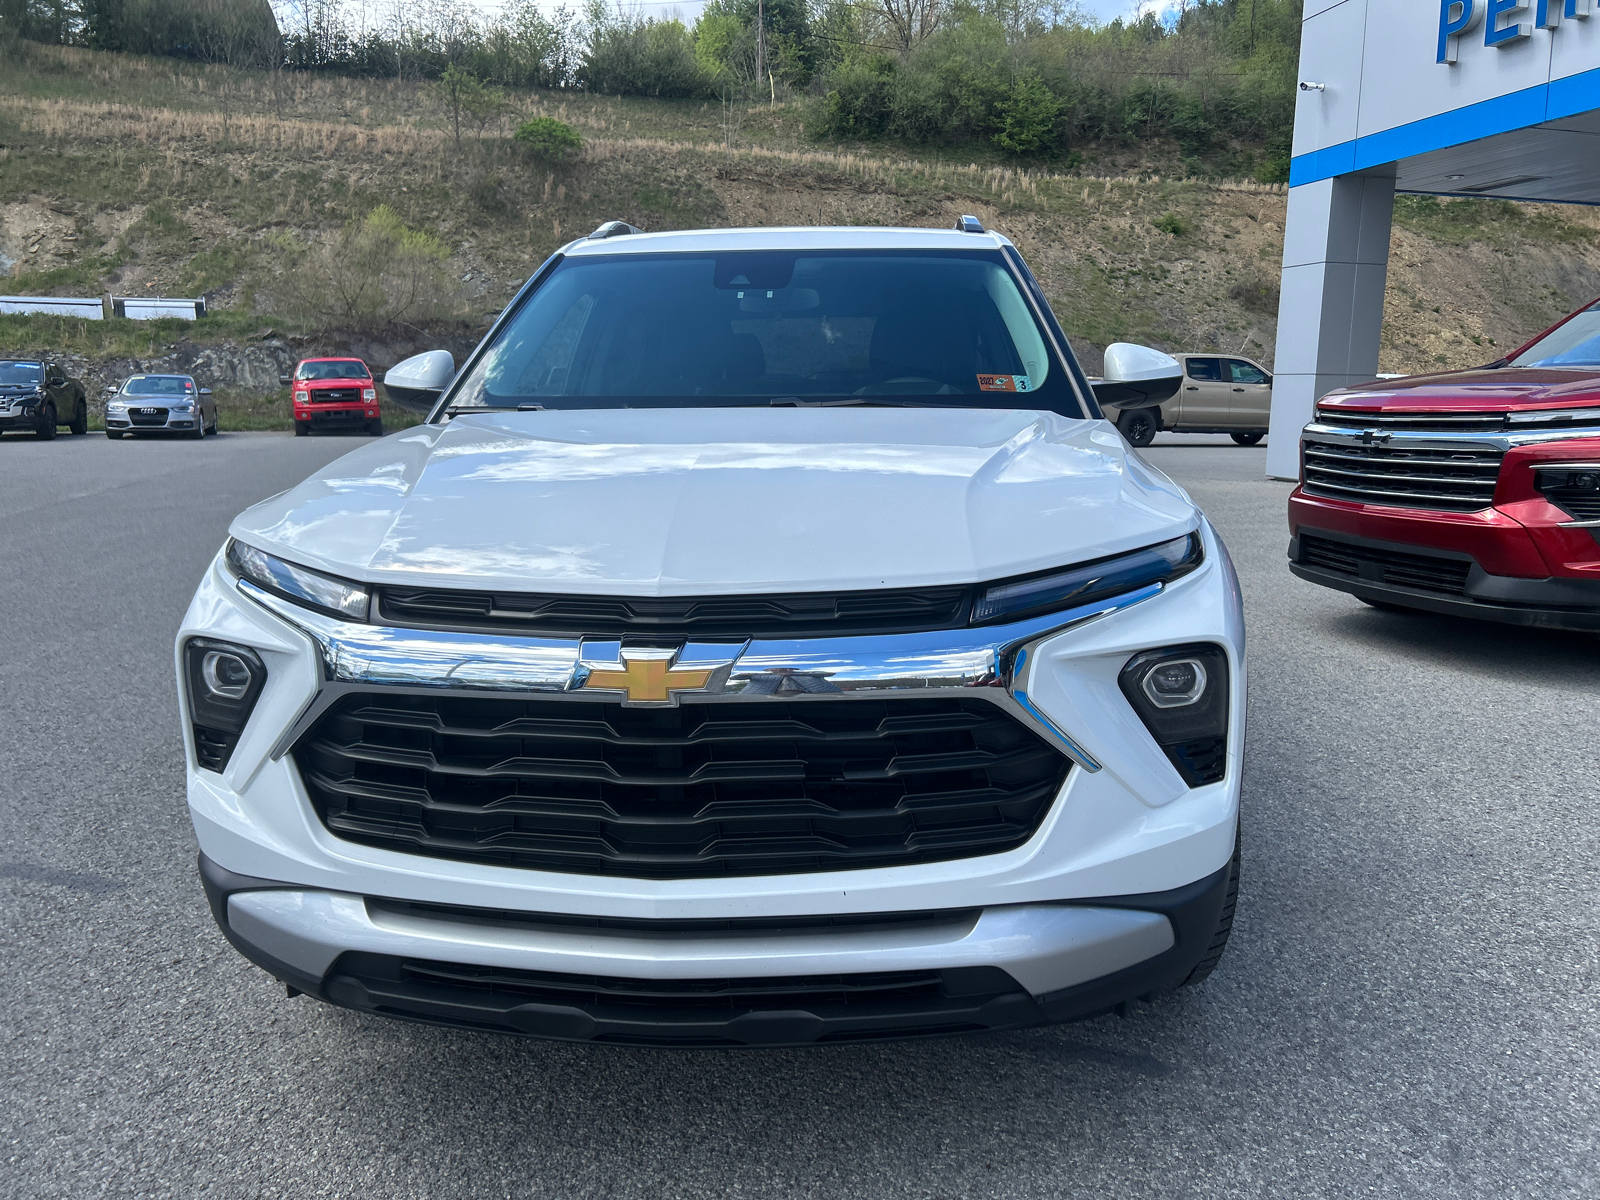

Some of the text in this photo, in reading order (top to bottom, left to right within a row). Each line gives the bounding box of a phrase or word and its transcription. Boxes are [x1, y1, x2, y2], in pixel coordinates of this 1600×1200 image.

[1436, 0, 1600, 64] PE
[979, 377, 994, 385] 2027
[1019, 380, 1027, 390] 3
